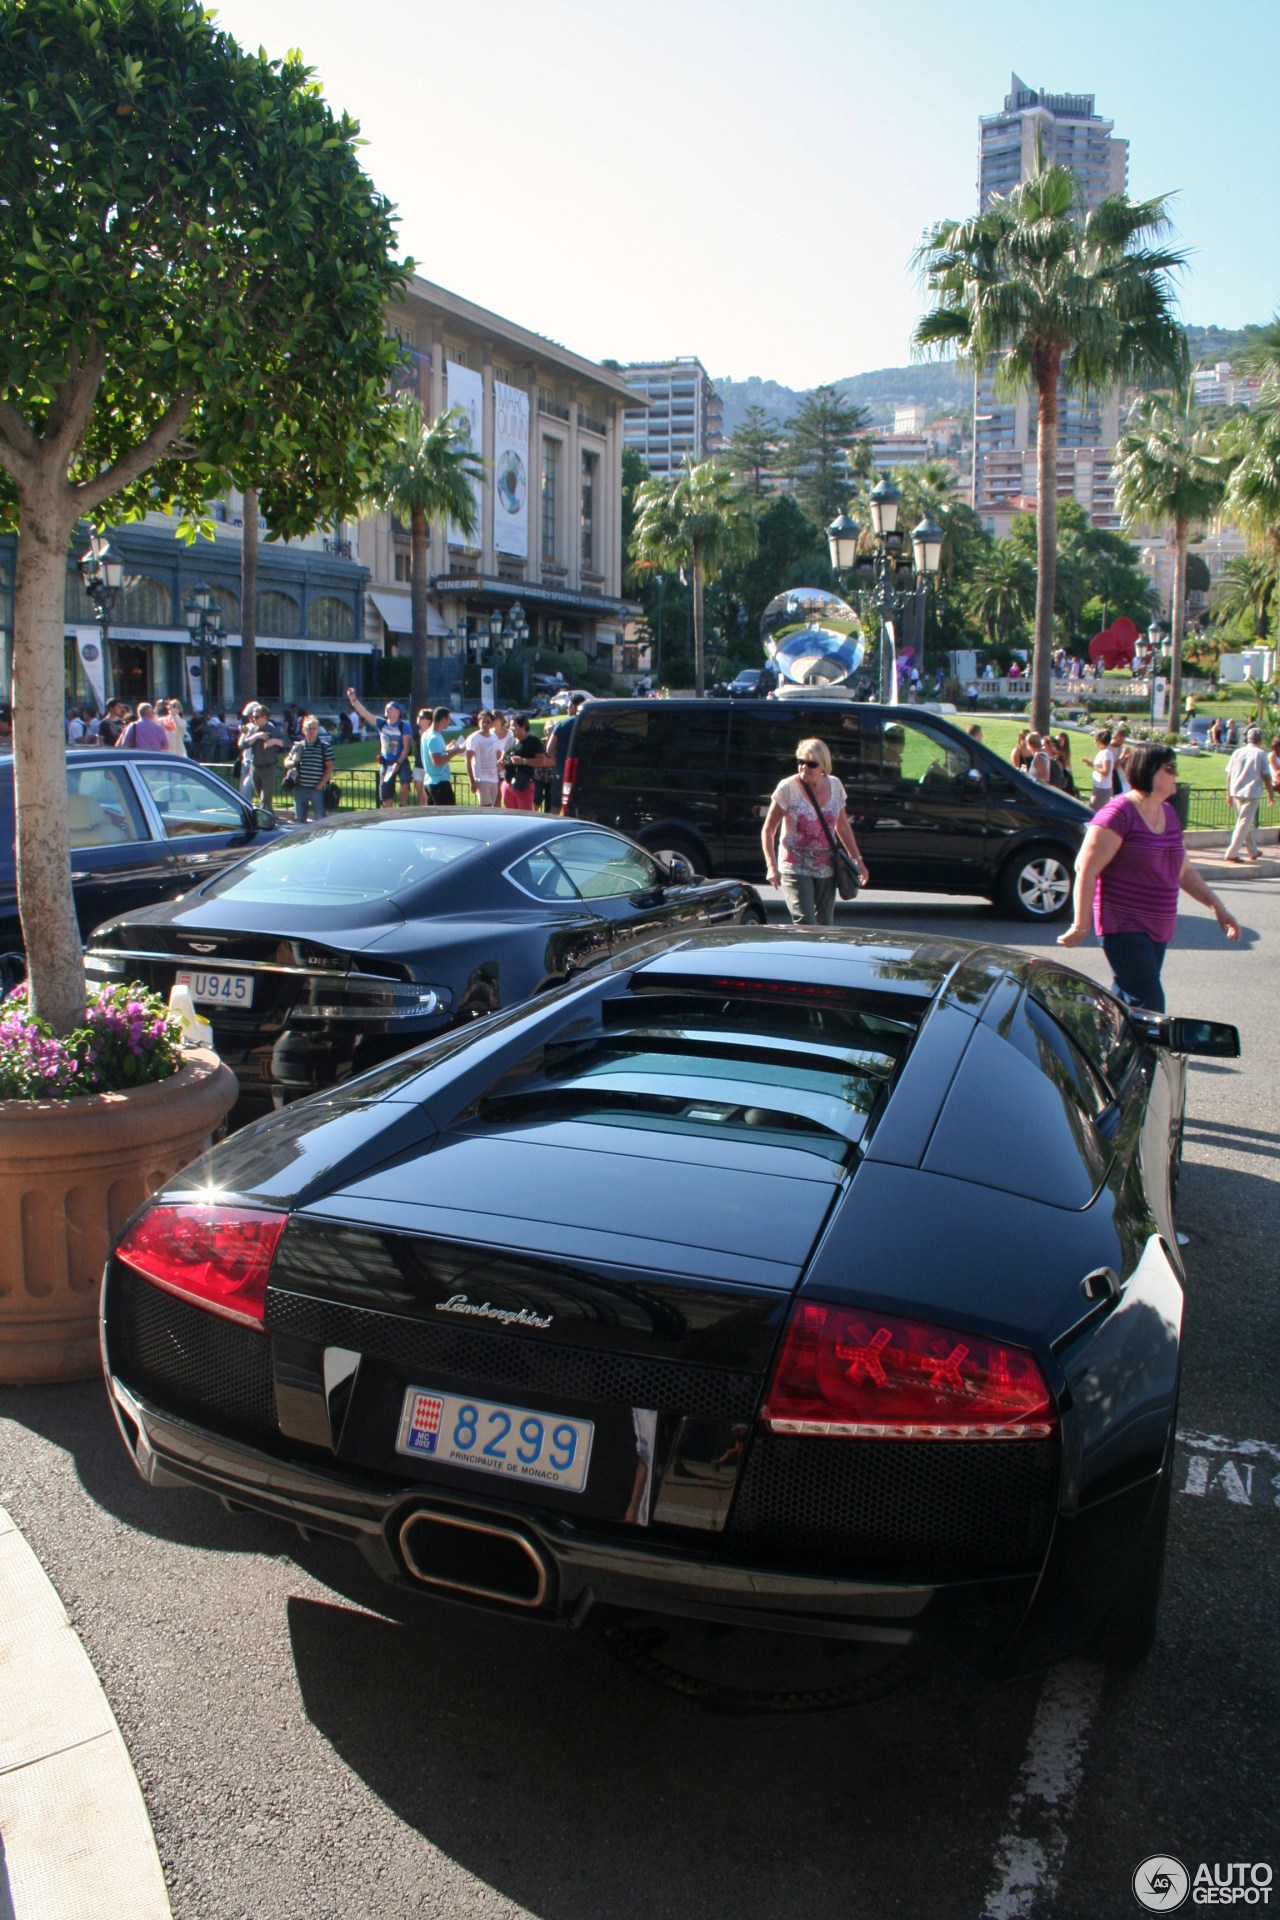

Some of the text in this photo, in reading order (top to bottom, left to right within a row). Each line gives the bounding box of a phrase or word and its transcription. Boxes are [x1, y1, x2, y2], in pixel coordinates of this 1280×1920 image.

[498, 384, 527, 417] MARC
[497, 409, 528, 442] QUINN
[437, 580, 478, 590] CINEMA
[114, 629, 141, 638] EMPIRE
[195, 975, 246, 999] U945
[435, 1294, 553, 1328] Lamborghini
[414, 1439, 431, 1448] 2012
[417, 1432, 430, 1441] MC
[453, 1404, 579, 1471] 8299
[450, 1450, 560, 1481] PRINCIPAUTE DE MONACO
